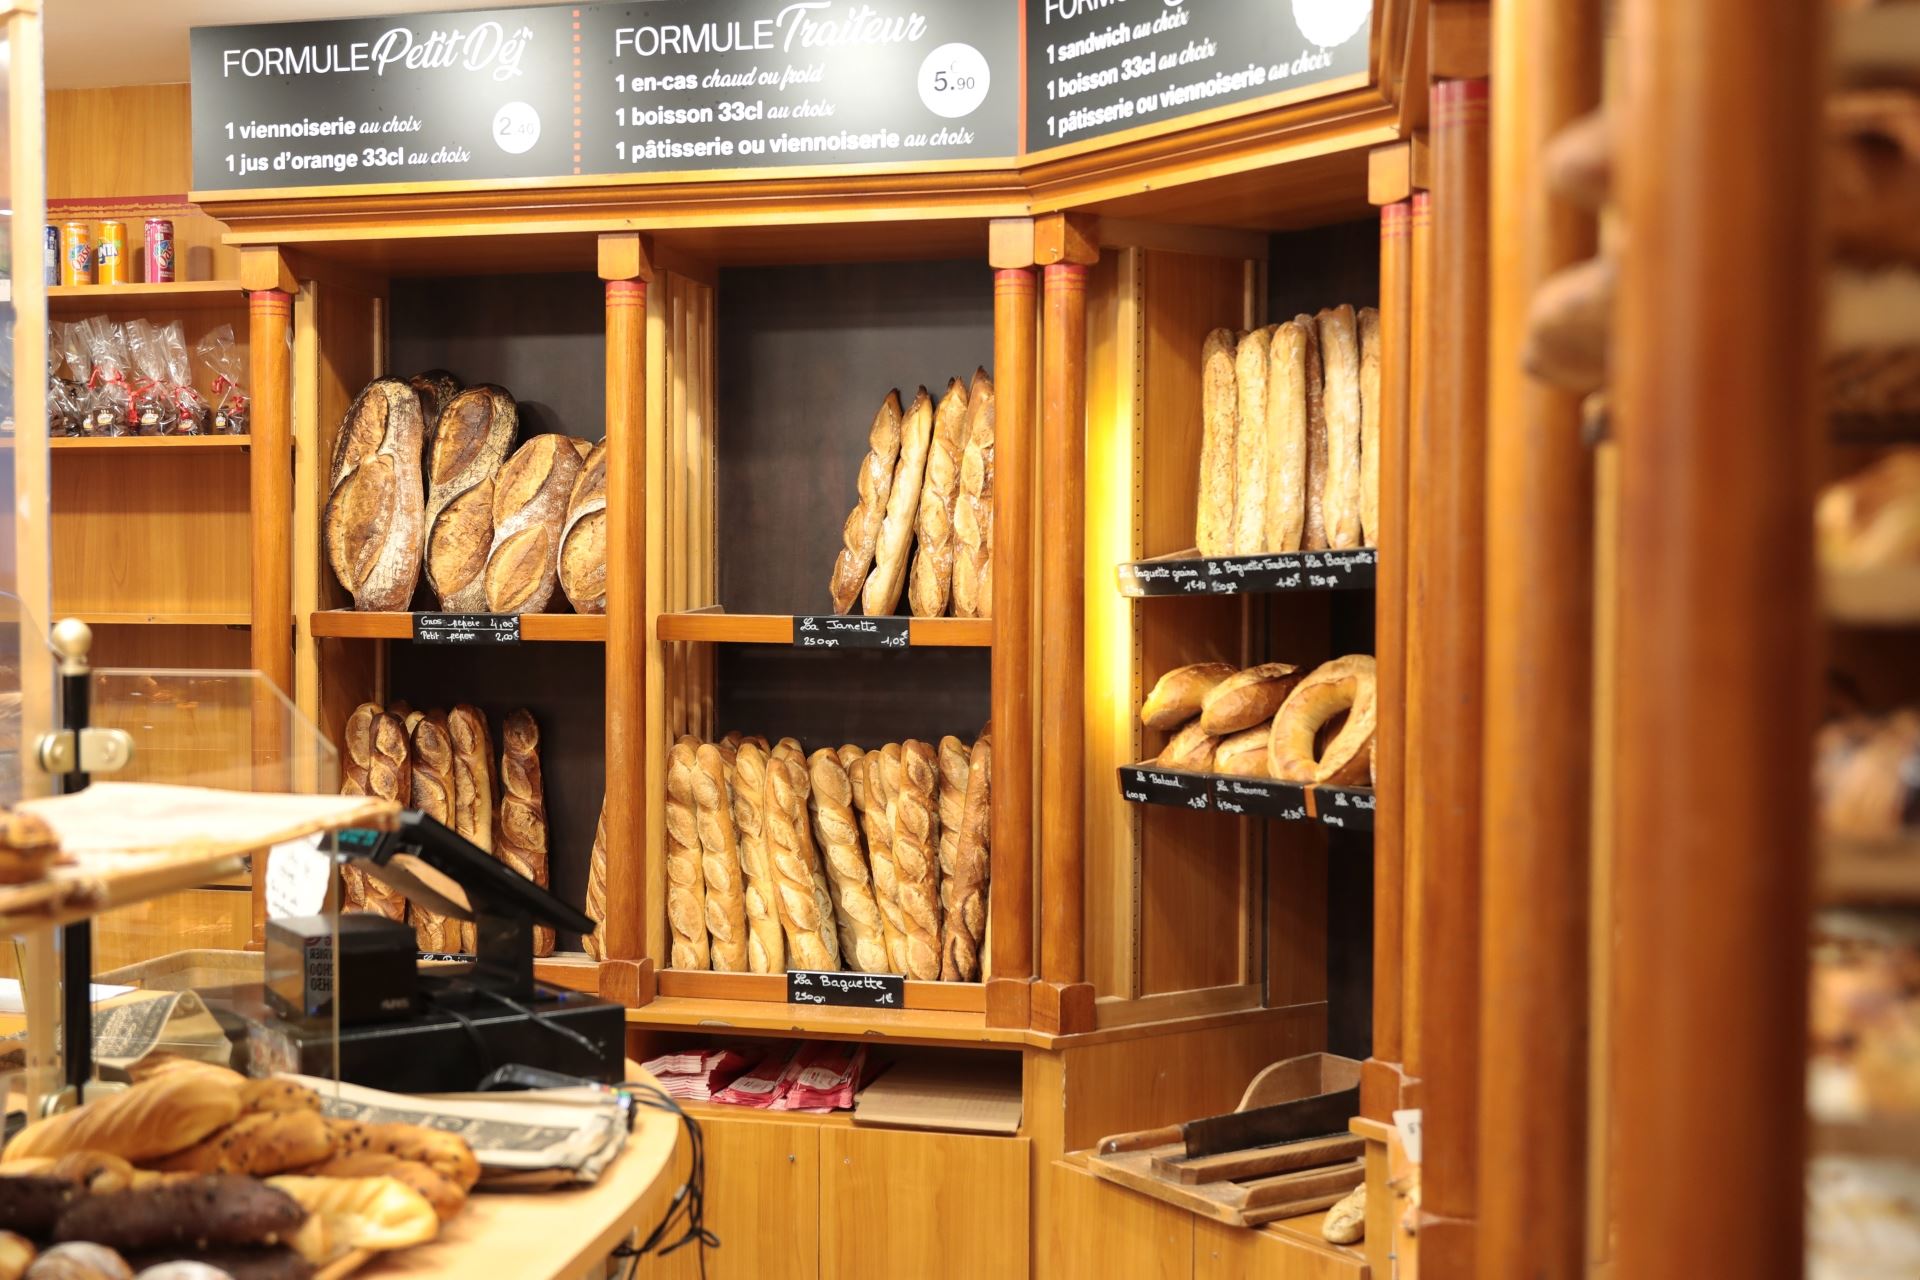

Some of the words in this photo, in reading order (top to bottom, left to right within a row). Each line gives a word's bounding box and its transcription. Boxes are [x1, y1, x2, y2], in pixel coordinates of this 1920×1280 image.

[615, 19, 774, 57] FORMULE
[775, 0, 928, 53] Traiteur
[1047, 44, 1055, 64] 1
[1058, 22, 1131, 61] sandwich
[1132, 22, 1151, 40] au
[1152, 6, 1190, 34] choix
[223, 42, 370, 77] FORMULE
[371, 27, 467, 77] Petit
[616, 74, 626, 93] 1
[631, 72, 698, 92] en-cas
[702, 66, 758, 89] chaud
[759, 71, 780, 85] ou
[779, 65, 824, 92] froid
[934, 71, 975, 92] 5.90
[1047, 80, 1055, 100] 1
[1058, 67, 1118, 97] boisson
[1121, 52, 1157, 81] 33cl
[1158, 52, 1179, 71] au
[1179, 37, 1217, 65] choix
[1047, 116, 1055, 136] 1
[1058, 97, 1134, 138] pâtisserie
[1136, 94, 1158, 114] ou
[1160, 64, 1266, 108] viennoiserie
[1268, 63, 1289, 81] au
[1290, 47, 1333, 75] choix
[616, 108, 626, 126] 1
[631, 104, 713, 126] boisson
[717, 100, 763, 122] 33cl
[767, 106, 791, 119] au
[791, 100, 836, 118] choix
[225, 122, 235, 140] 1
[240, 117, 356, 140] viennoiserie
[359, 122, 381, 135] au
[381, 115, 422, 134] choix
[616, 141, 626, 160] 1
[631, 135, 734, 163] pâtisserie
[738, 137, 766, 155] ou
[768, 128, 900, 154] viennoiserie
[903, 134, 928, 148] au
[928, 126, 974, 146] choix
[225, 154, 235, 172] 1
[239, 153, 269, 176] jus
[273, 148, 358, 173] d'orange
[362, 147, 404, 167] 33cl
[408, 152, 429, 166] au
[429, 146, 471, 165] choix
[1223, 560, 1263, 578] Baguette
[1324, 552, 1373, 573] Baguette
[420, 615, 443, 626] Gros
[799, 617, 820, 631] La
[826, 620, 878, 632] Janette
[420, 630, 440, 640] Petit
[793, 973, 813, 986] La
[819, 975, 887, 992] Baguette
